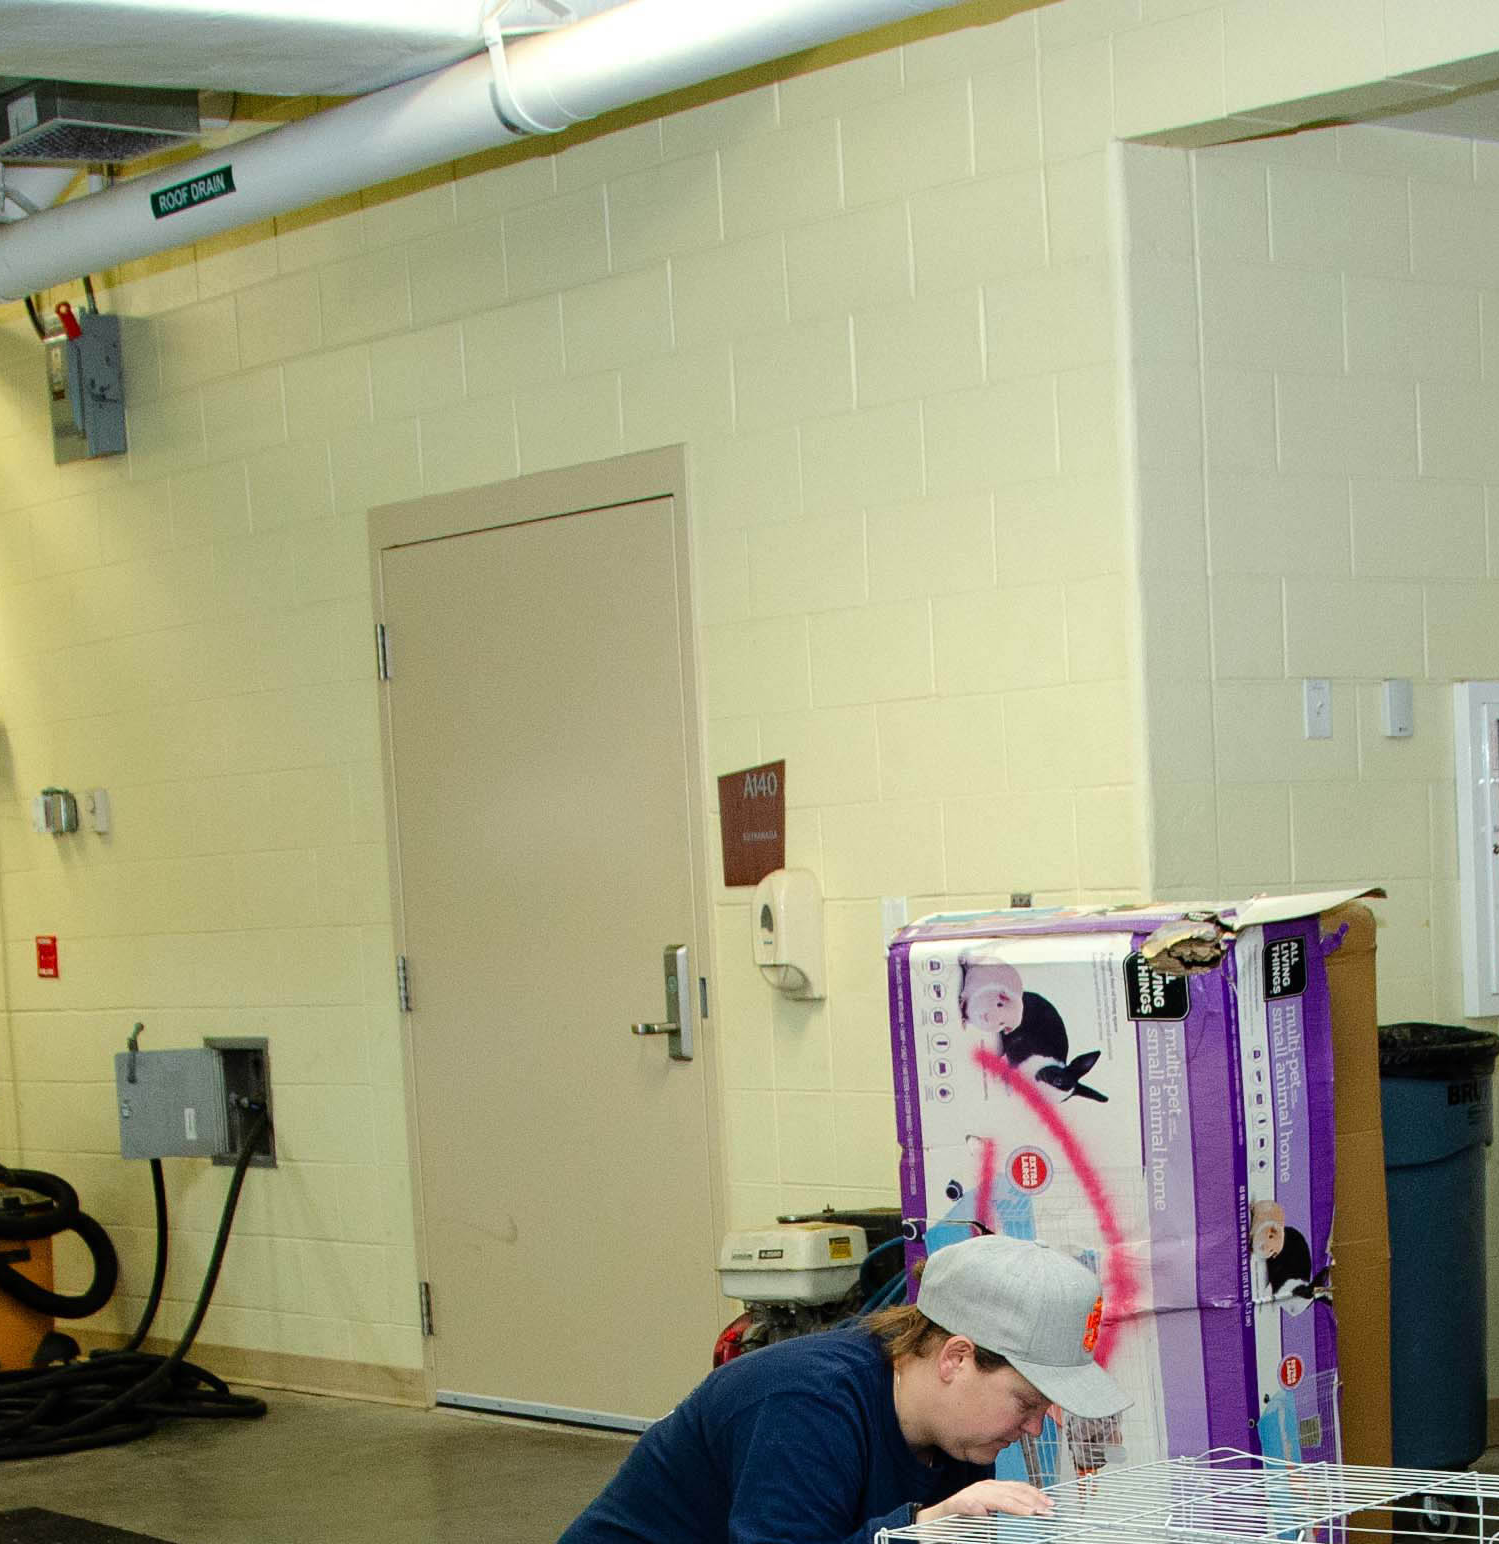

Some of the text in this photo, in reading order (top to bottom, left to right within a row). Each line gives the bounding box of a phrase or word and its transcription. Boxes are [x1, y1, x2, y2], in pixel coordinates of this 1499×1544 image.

[158, 172, 226, 212] ROOF DRAIN
[743, 771, 778, 800] A140
[1271, 943, 1282, 994] THINGS
[1280, 942, 1291, 987] LIVING
[1289, 941, 1299, 965] ALL
[1159, 1027, 1182, 1115] multi-pet
[1285, 1004, 1301, 1088] multi-pet
[1146, 1026, 1169, 1211] small animal home
[1272, 1007, 1294, 1183] small animal home
